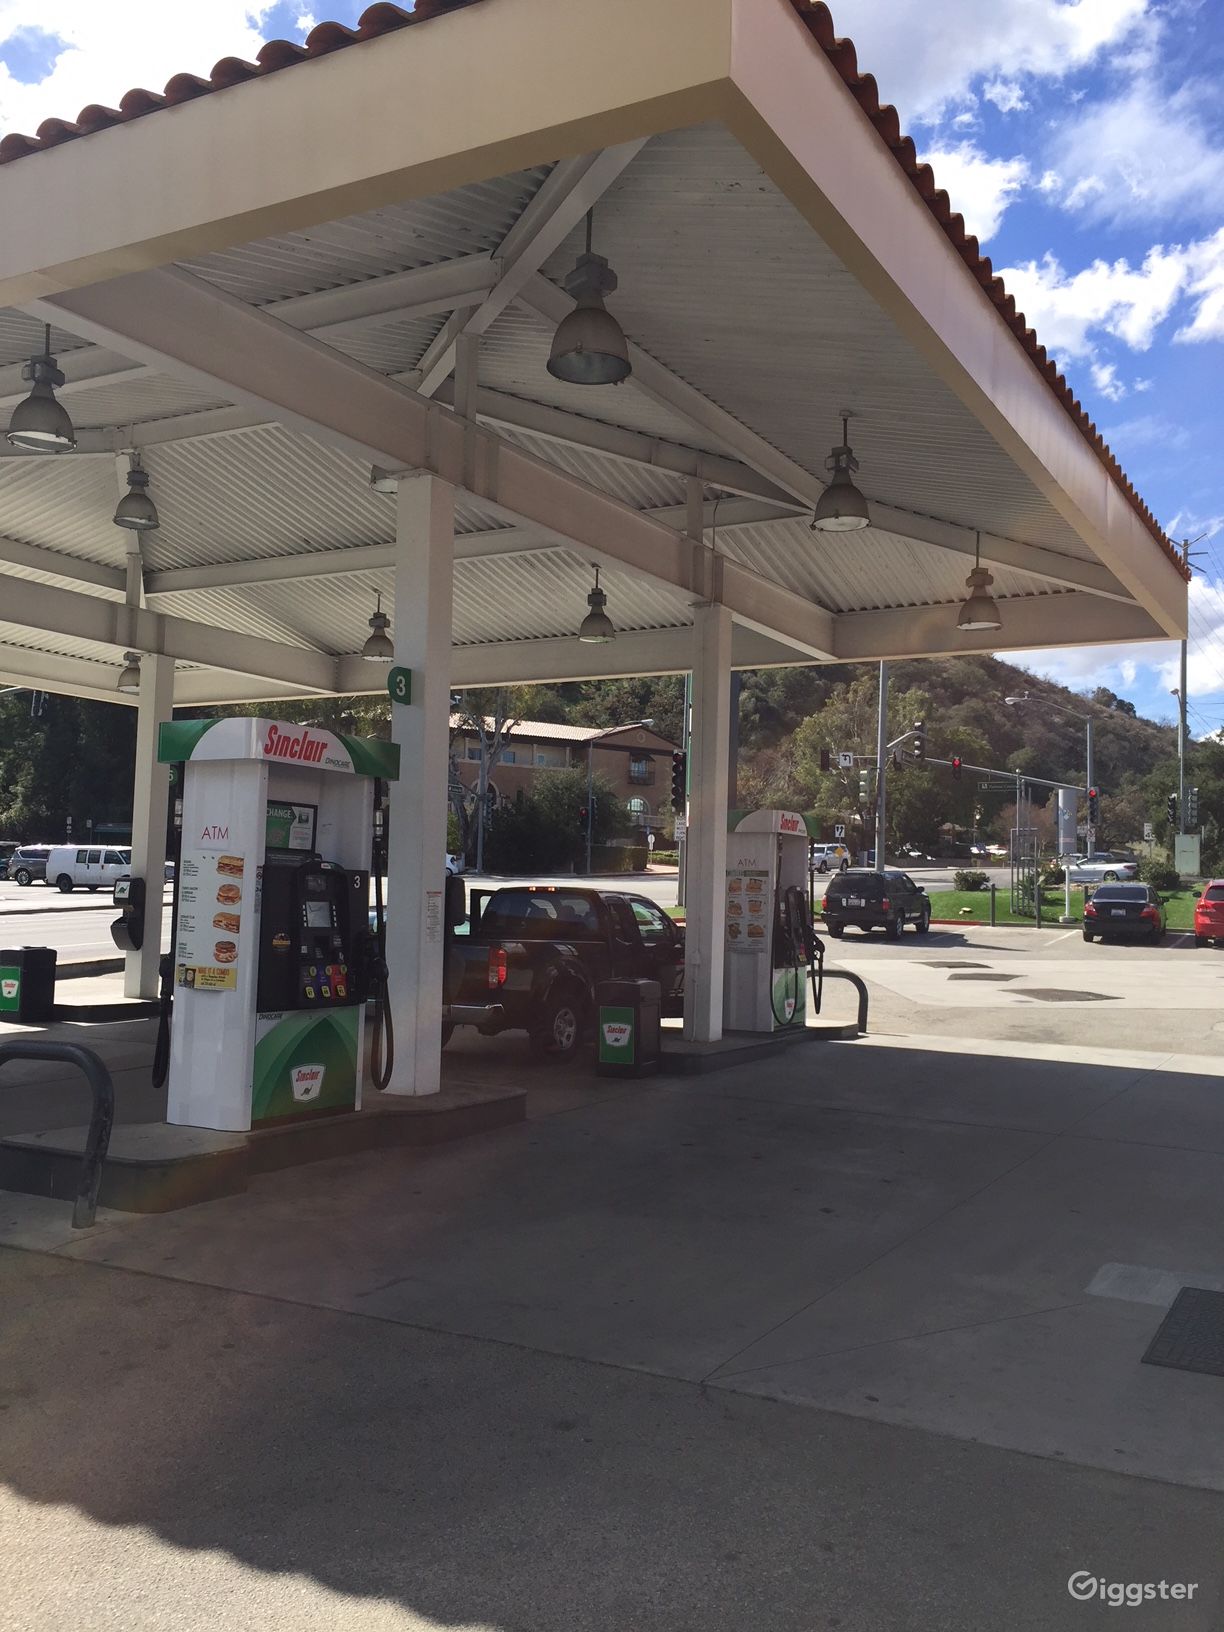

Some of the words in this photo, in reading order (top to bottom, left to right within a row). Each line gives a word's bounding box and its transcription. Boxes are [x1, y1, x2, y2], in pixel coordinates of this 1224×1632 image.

[396, 675, 406, 697] 3
[264, 724, 328, 763] Sinclair
[201, 826, 229, 840] ATM
[738, 858, 757, 867] ATM
[353, 875, 361, 889] 3
